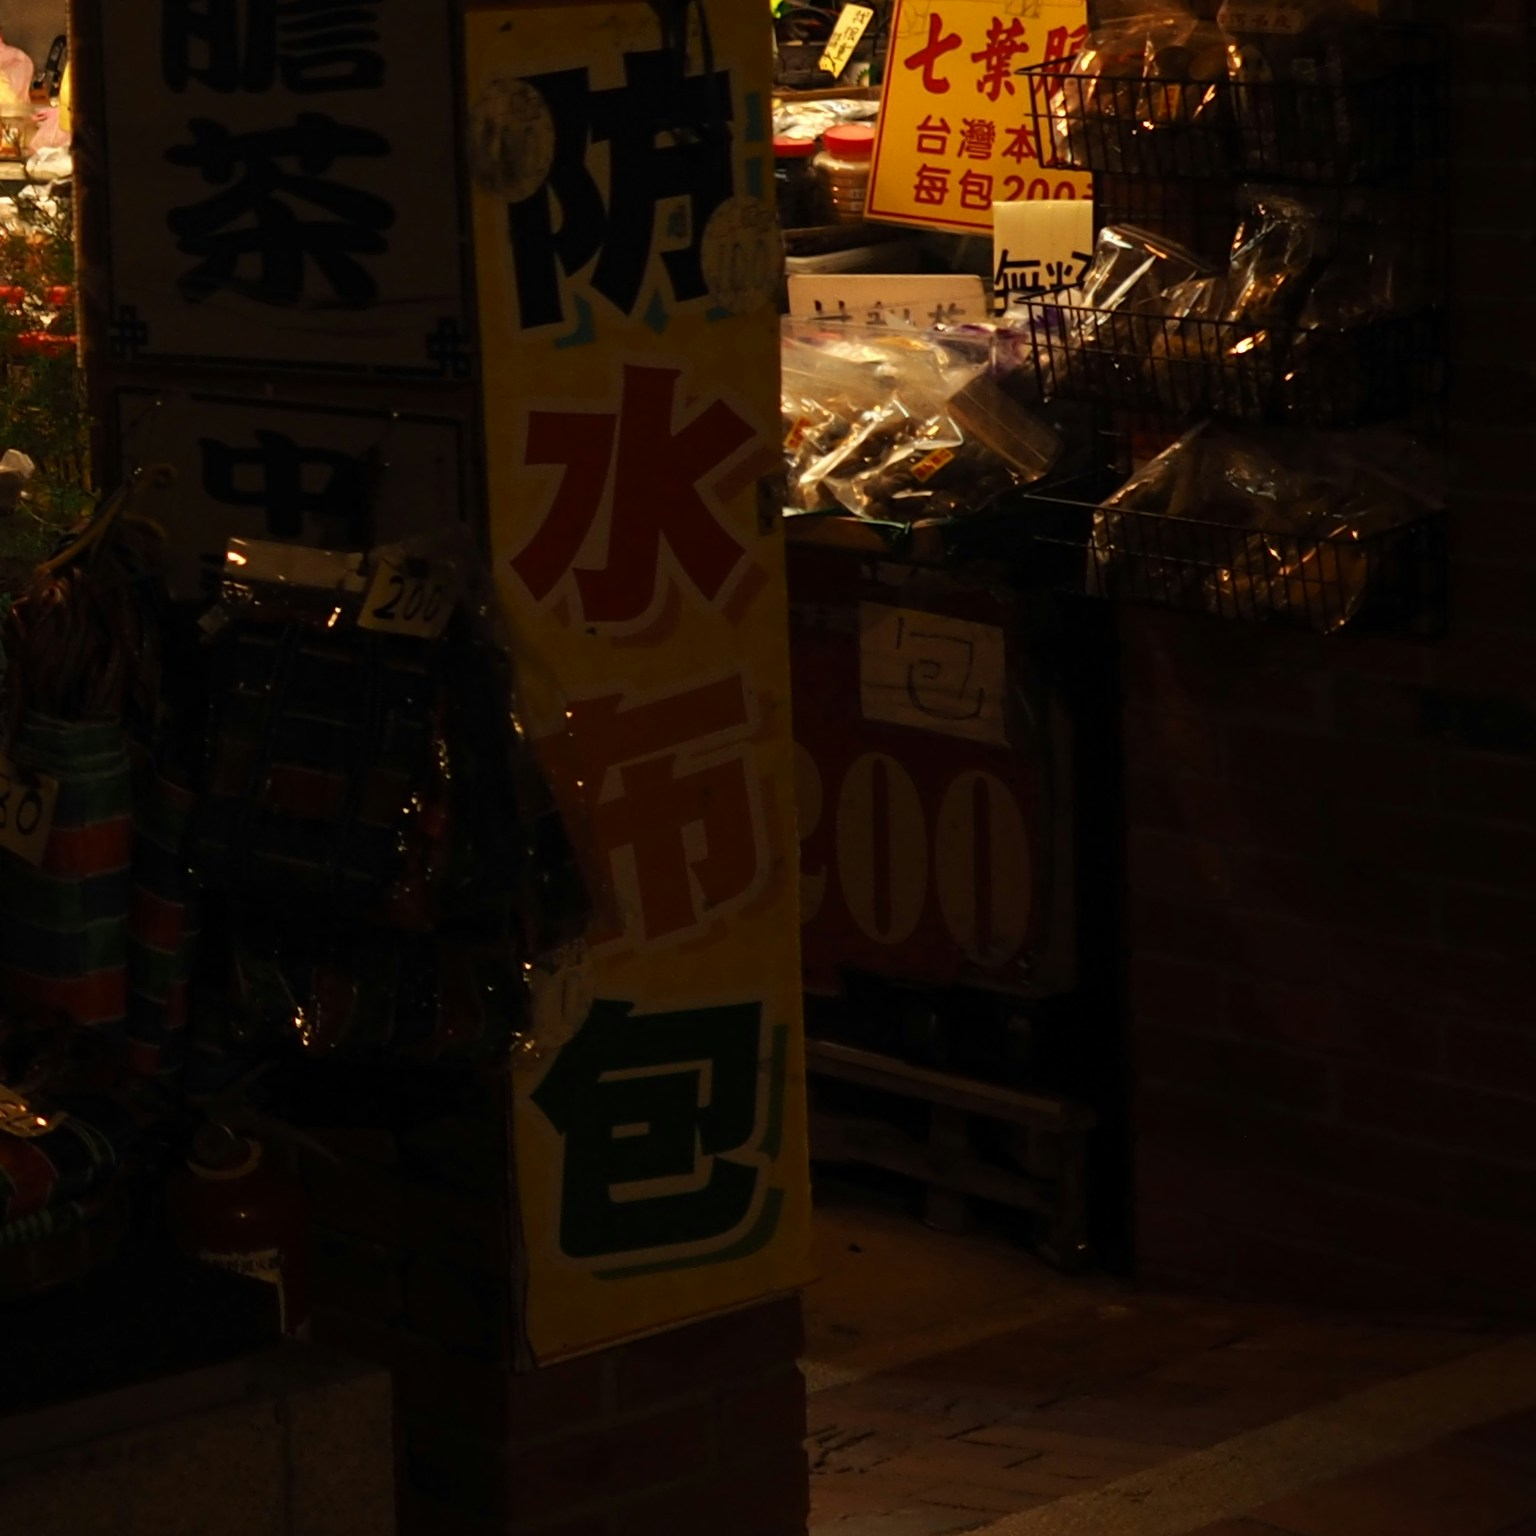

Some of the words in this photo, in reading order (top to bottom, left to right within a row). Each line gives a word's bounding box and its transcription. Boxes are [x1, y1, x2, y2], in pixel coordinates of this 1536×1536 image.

[913, 163, 1093, 212] 每包200
[508, 66, 771, 1261] 防水布包
[890, 614, 988, 722] 包
